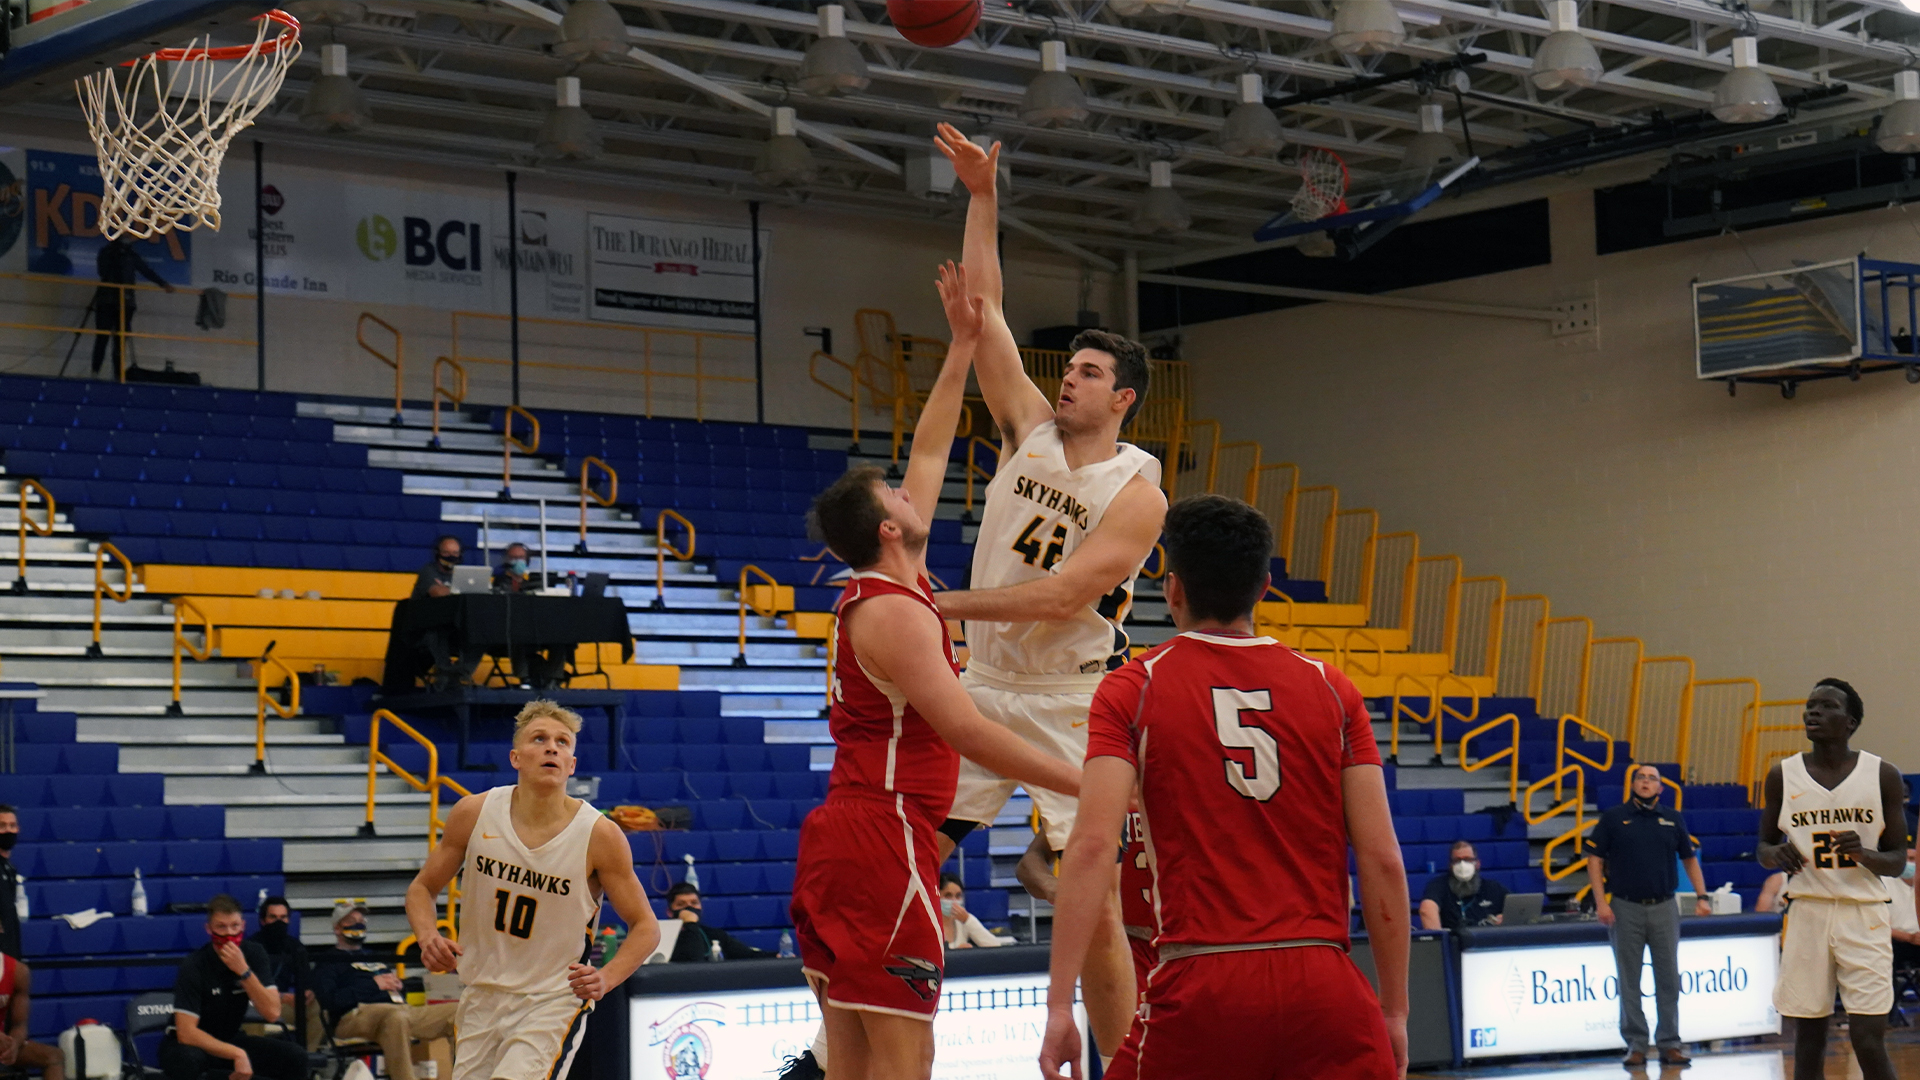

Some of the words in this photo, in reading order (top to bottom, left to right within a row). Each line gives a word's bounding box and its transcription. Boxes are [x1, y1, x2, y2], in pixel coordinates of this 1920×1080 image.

[248, 229, 295, 243] Wstern
[403, 216, 482, 272] BCI
[593, 226, 626, 253] THE
[629, 230, 699, 260] DURANGO
[702, 237, 758, 265] HERAL
[494, 248, 546, 273] MONTAIN
[213, 269, 239, 285] Rio
[243, 272, 298, 290] Gande
[303, 277, 328, 292] Inn
[1010, 514, 1069, 572] 42
[1211, 686, 1282, 802] 5
[1791, 808, 1874, 828] SKYHAWKS
[476, 855, 571, 896] SKYHAWKS
[494, 887, 539, 940] 10
[1532, 964, 1597, 1006] Bank
[772, 1038, 798, 1061] Go
[981, 1029, 996, 1044] to
